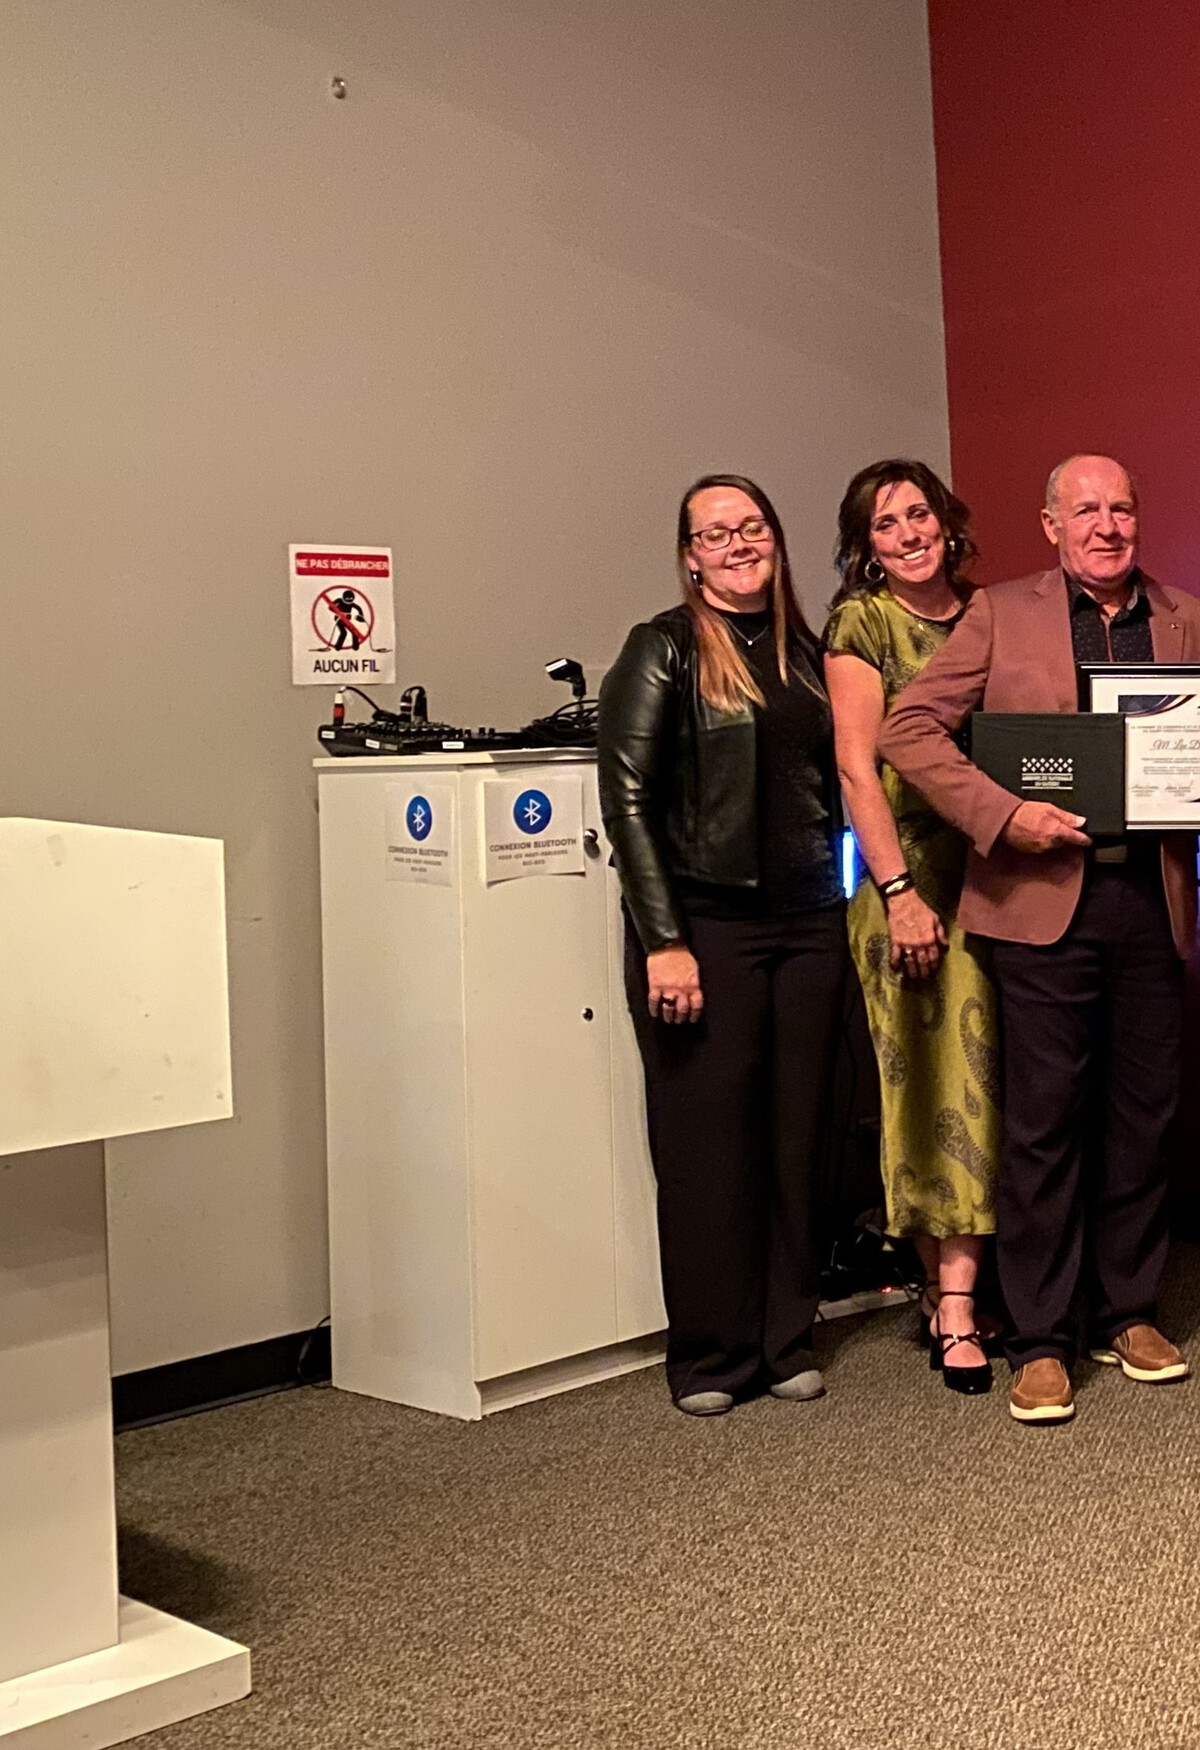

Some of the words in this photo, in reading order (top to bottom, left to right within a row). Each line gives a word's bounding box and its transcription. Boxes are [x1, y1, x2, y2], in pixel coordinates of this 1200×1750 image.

[296, 558, 308, 569] NE
[310, 559, 329, 569] PAS
[331, 557, 389, 571] DÉBRANCHER
[313, 659, 358, 673] AUCUN
[362, 659, 380, 672] FIL
[489, 842, 531, 852] CONNEXION
[534, 838, 576, 848] BLUETOOTH
